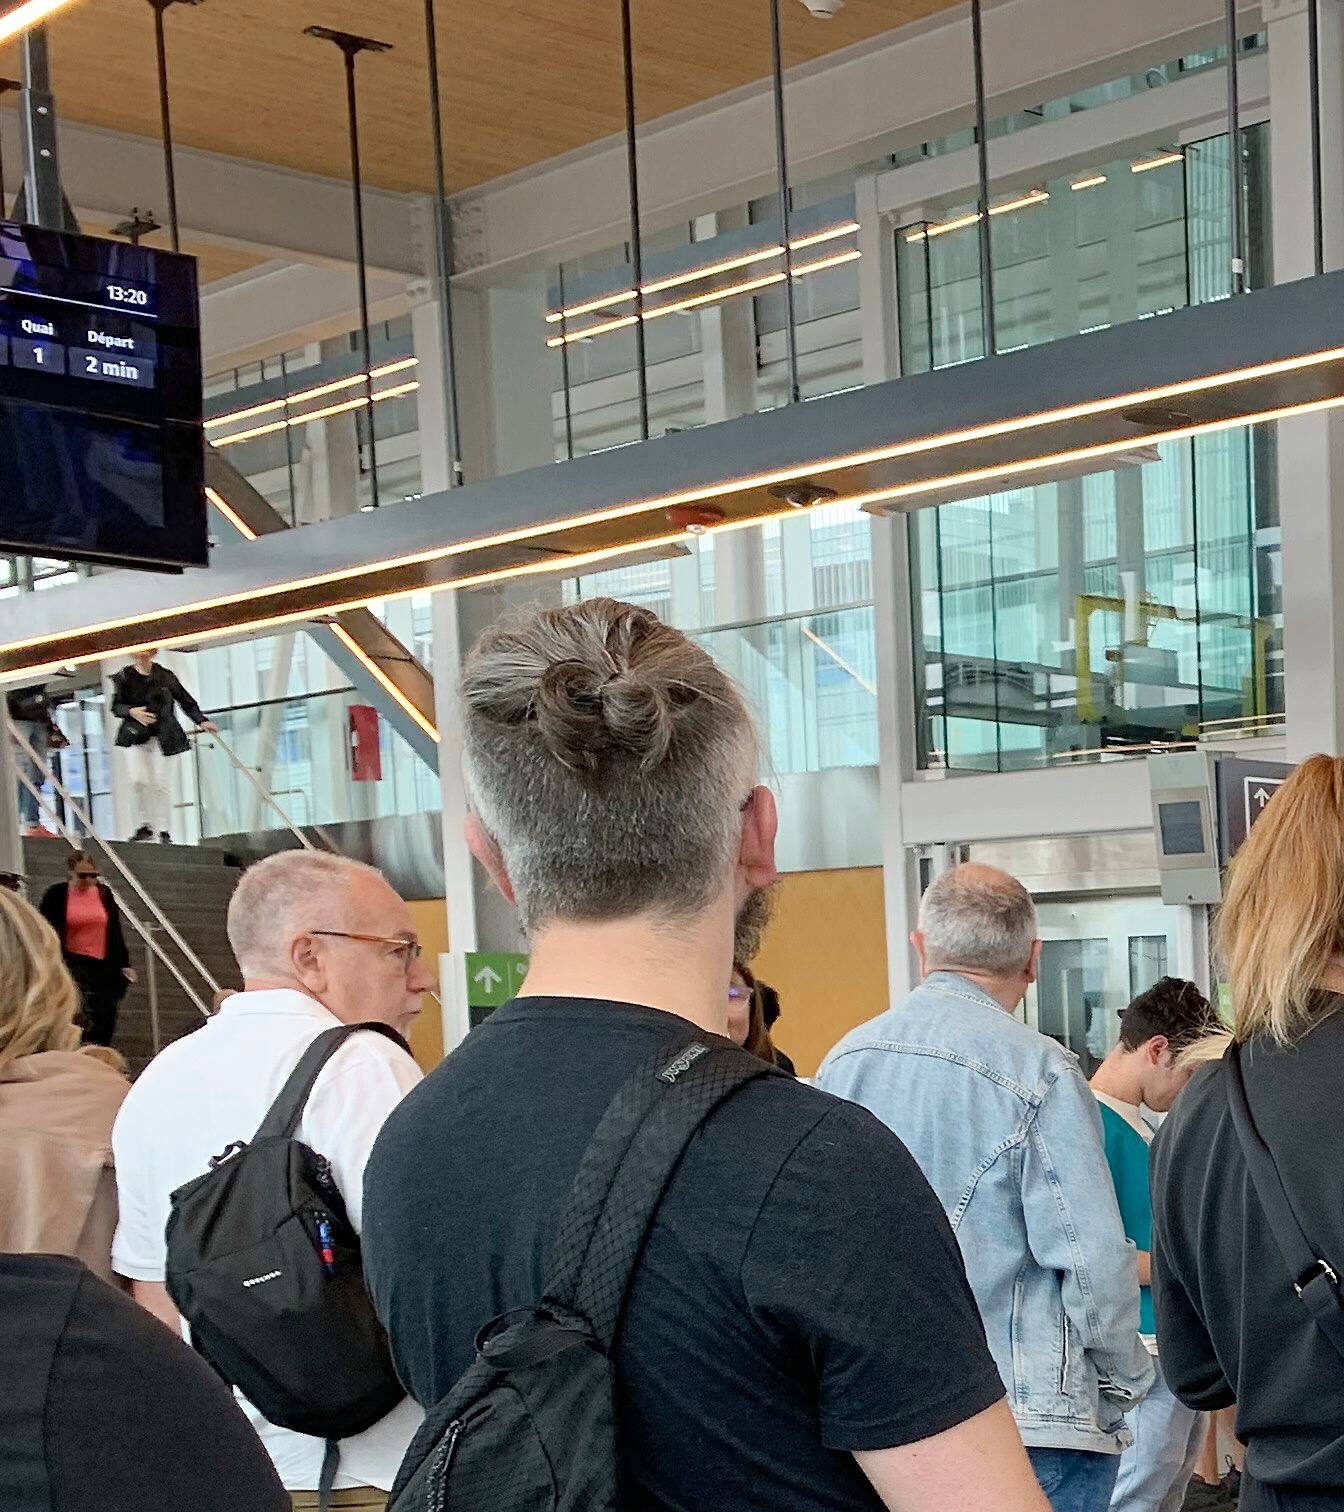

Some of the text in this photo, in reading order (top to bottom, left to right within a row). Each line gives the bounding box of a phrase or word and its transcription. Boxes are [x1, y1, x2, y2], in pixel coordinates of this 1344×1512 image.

[106, 285, 147, 305] 13:20
[21, 319, 53, 335] Quai
[87, 330, 134, 349] Départ
[32, 347, 43, 364] 1
[86, 356, 138, 379] 2 min
